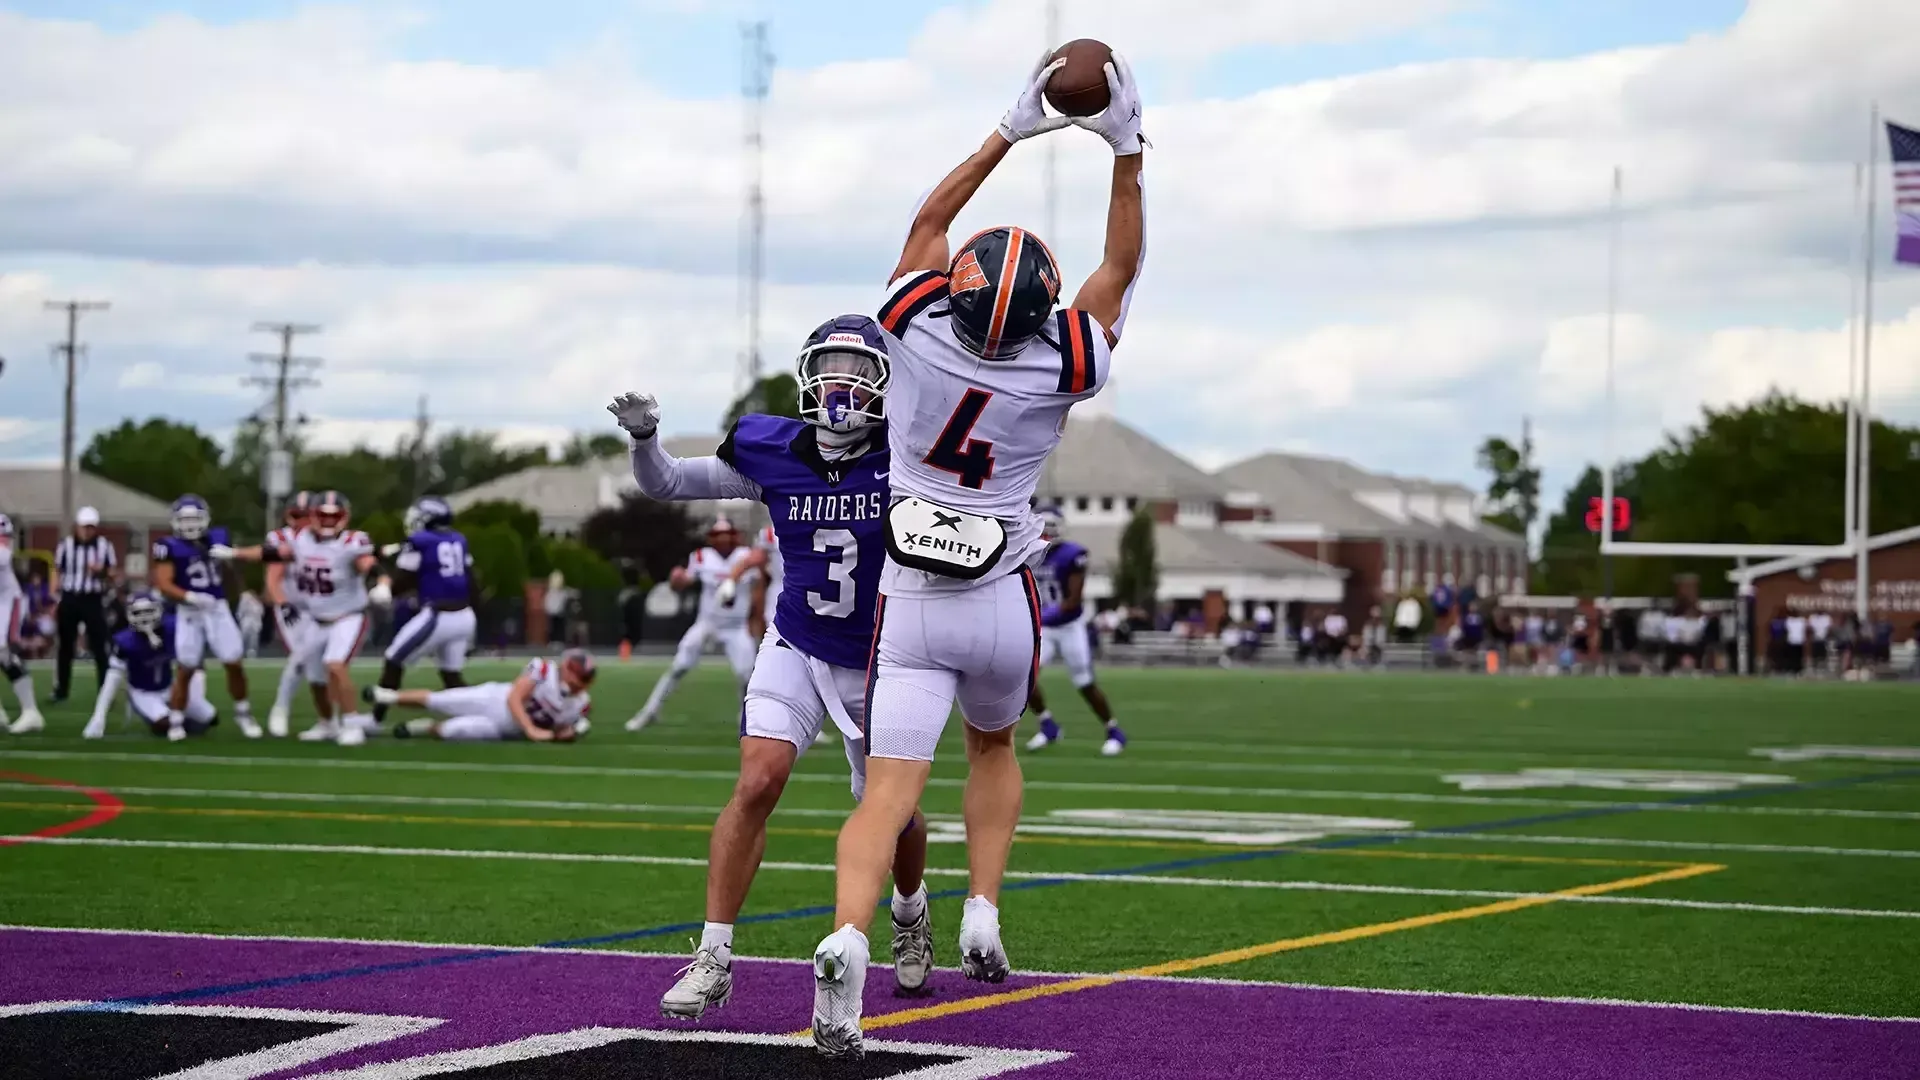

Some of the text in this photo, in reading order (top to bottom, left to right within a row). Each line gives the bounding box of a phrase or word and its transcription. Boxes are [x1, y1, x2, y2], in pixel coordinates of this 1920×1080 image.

[828, 335, 862, 344] Riddell
[920, 387, 994, 491] 4
[827, 470, 840, 483] M
[788, 492, 881, 521] RAIDERS
[437, 541, 464, 577] 91
[903, 532, 982, 559] XENITH
[807, 528, 858, 618] 3
